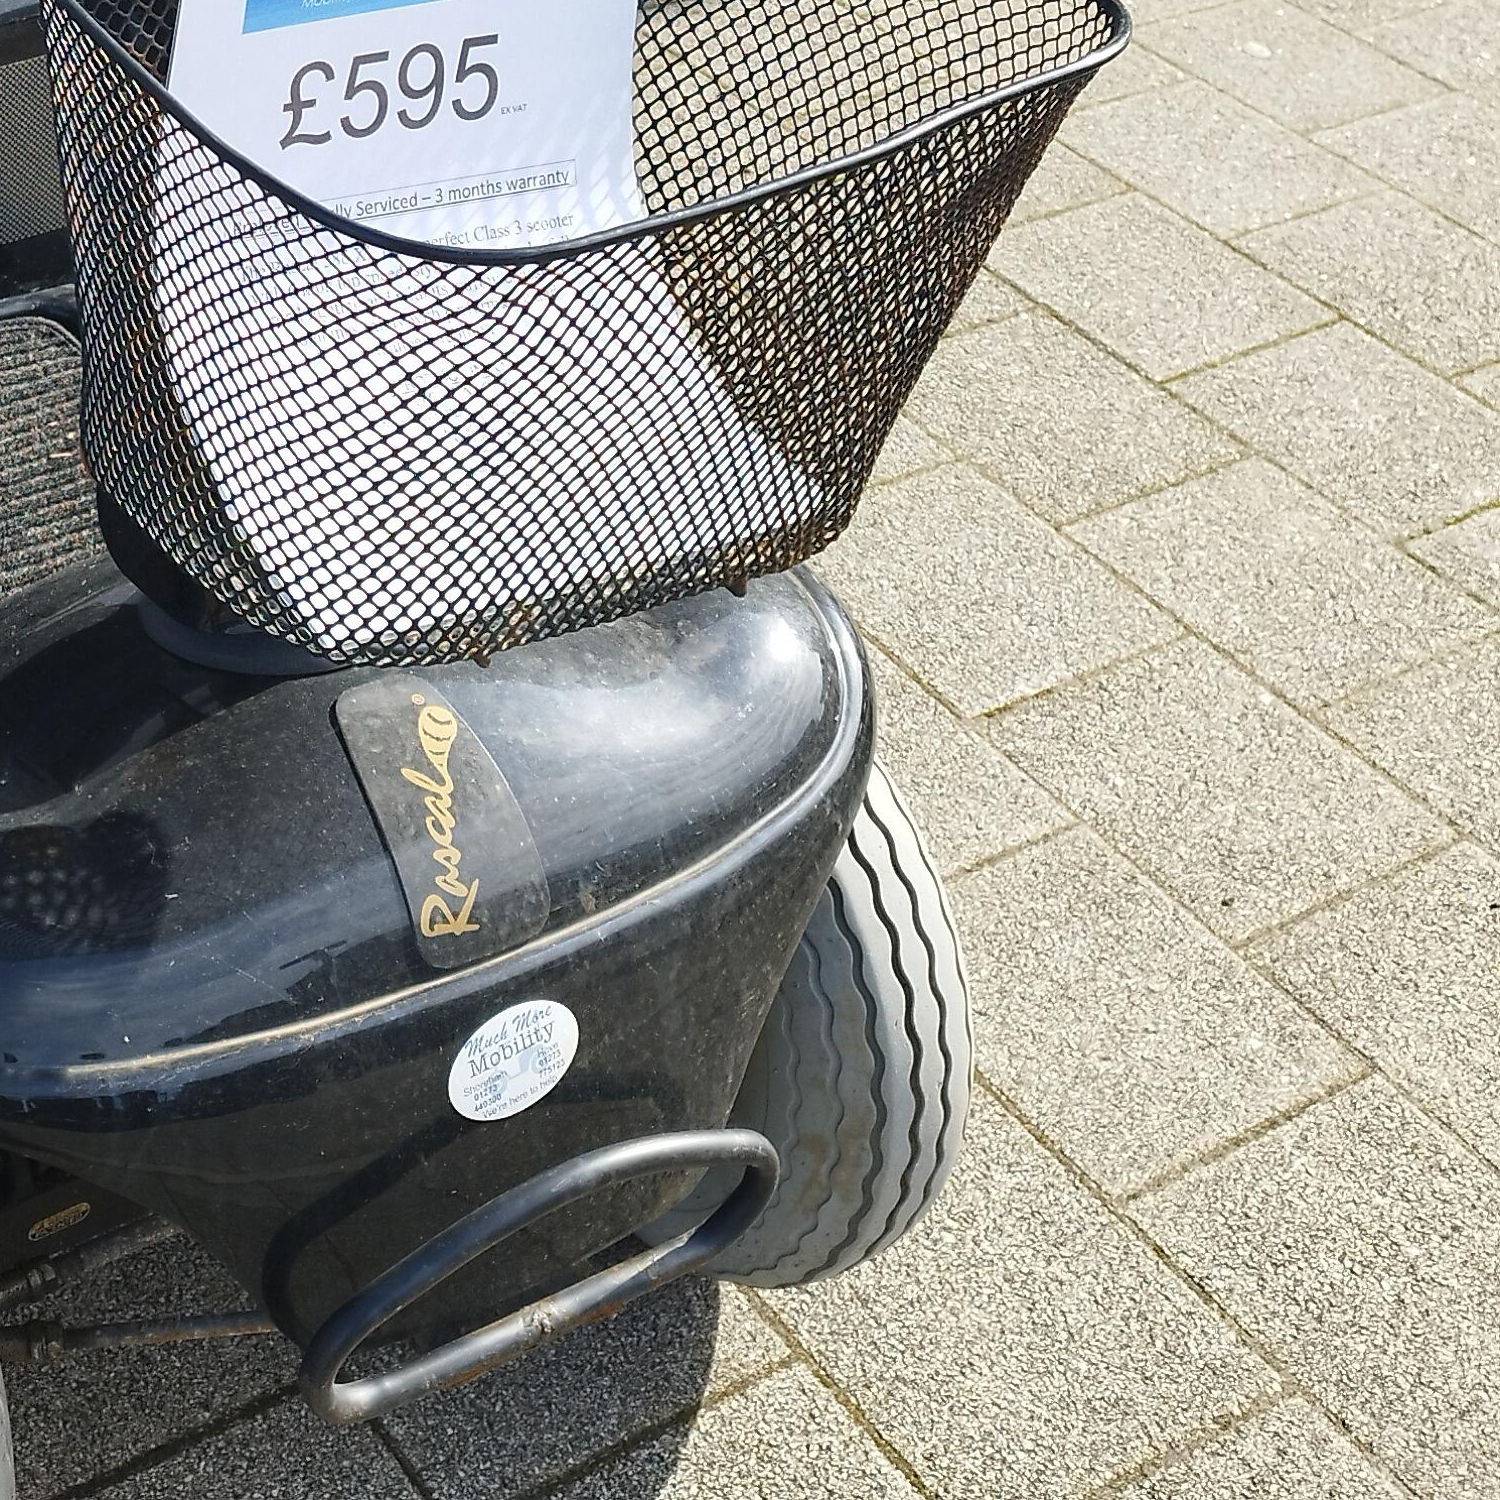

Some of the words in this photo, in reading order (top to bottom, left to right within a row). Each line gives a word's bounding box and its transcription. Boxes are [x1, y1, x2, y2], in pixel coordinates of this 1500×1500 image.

[279, 34, 499, 151] £595
[501, 107, 511, 115] EX
[511, 104, 528, 113] VAT
[356, 192, 418, 217] Serviced
[435, 188, 443, 204] 3
[449, 178, 502, 202] months
[505, 169, 570, 192] warranty
[473, 223, 510, 244] Class
[514, 219, 522, 237] 3
[526, 213, 575, 232] scooter
[401, 745, 480, 938] Rascal
[464, 1021, 509, 1058] Much
[512, 1005, 553, 1033] More
[468, 1021, 555, 1079] Mobility
[538, 1049, 562, 1067] 01273
[463, 1070, 508, 1098] Shoreham
[509, 1091, 529, 1106] here
[530, 1086, 539, 1096] to
